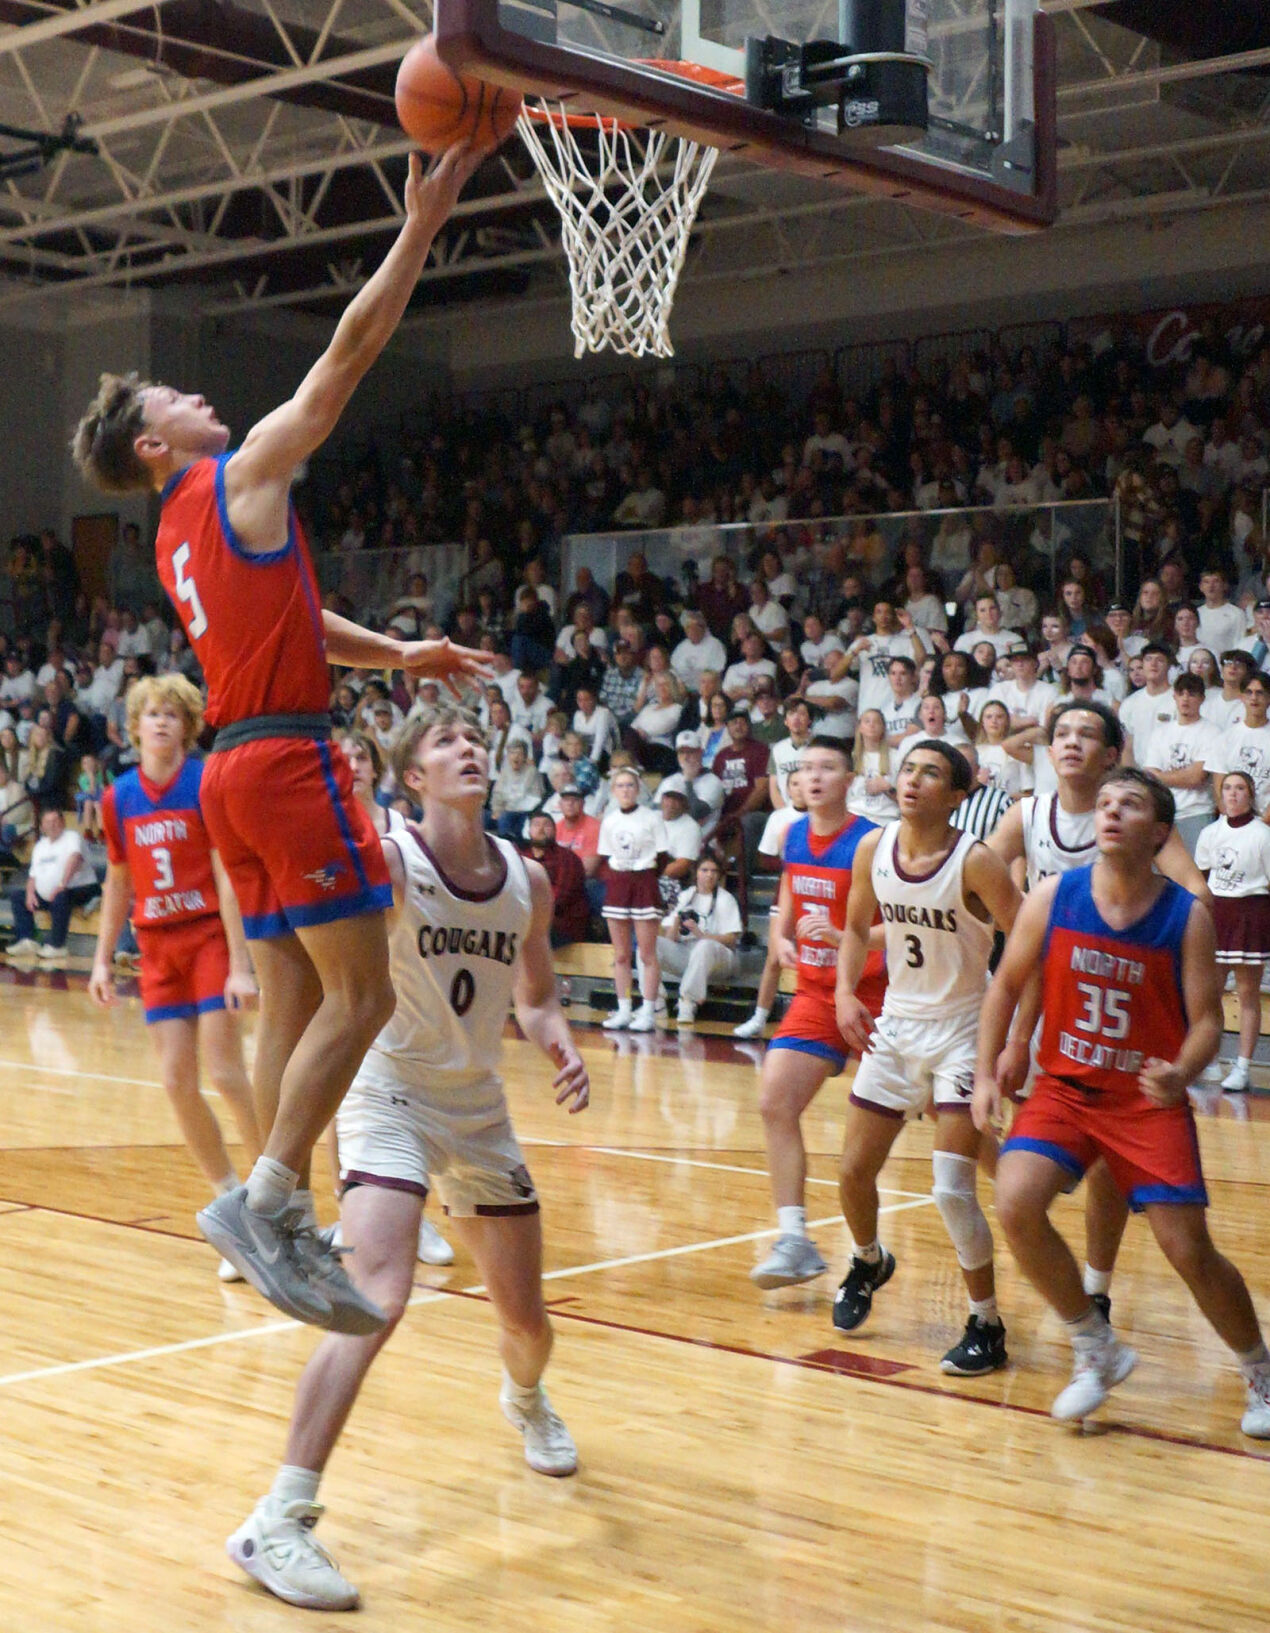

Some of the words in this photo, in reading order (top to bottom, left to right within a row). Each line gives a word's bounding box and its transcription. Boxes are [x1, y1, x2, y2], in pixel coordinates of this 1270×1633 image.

[171, 541, 209, 640] 5
[134, 819, 188, 848] NORTH
[151, 847, 175, 891] 3
[881, 902, 958, 933] OUGARS
[417, 924, 518, 967] COUGARS
[904, 933, 924, 969] 3
[1070, 945, 1146, 985] NORTH
[449, 967, 475, 1018] 0
[1074, 980, 1132, 1040] 35
[1059, 1030, 1146, 1074] DECATUR
